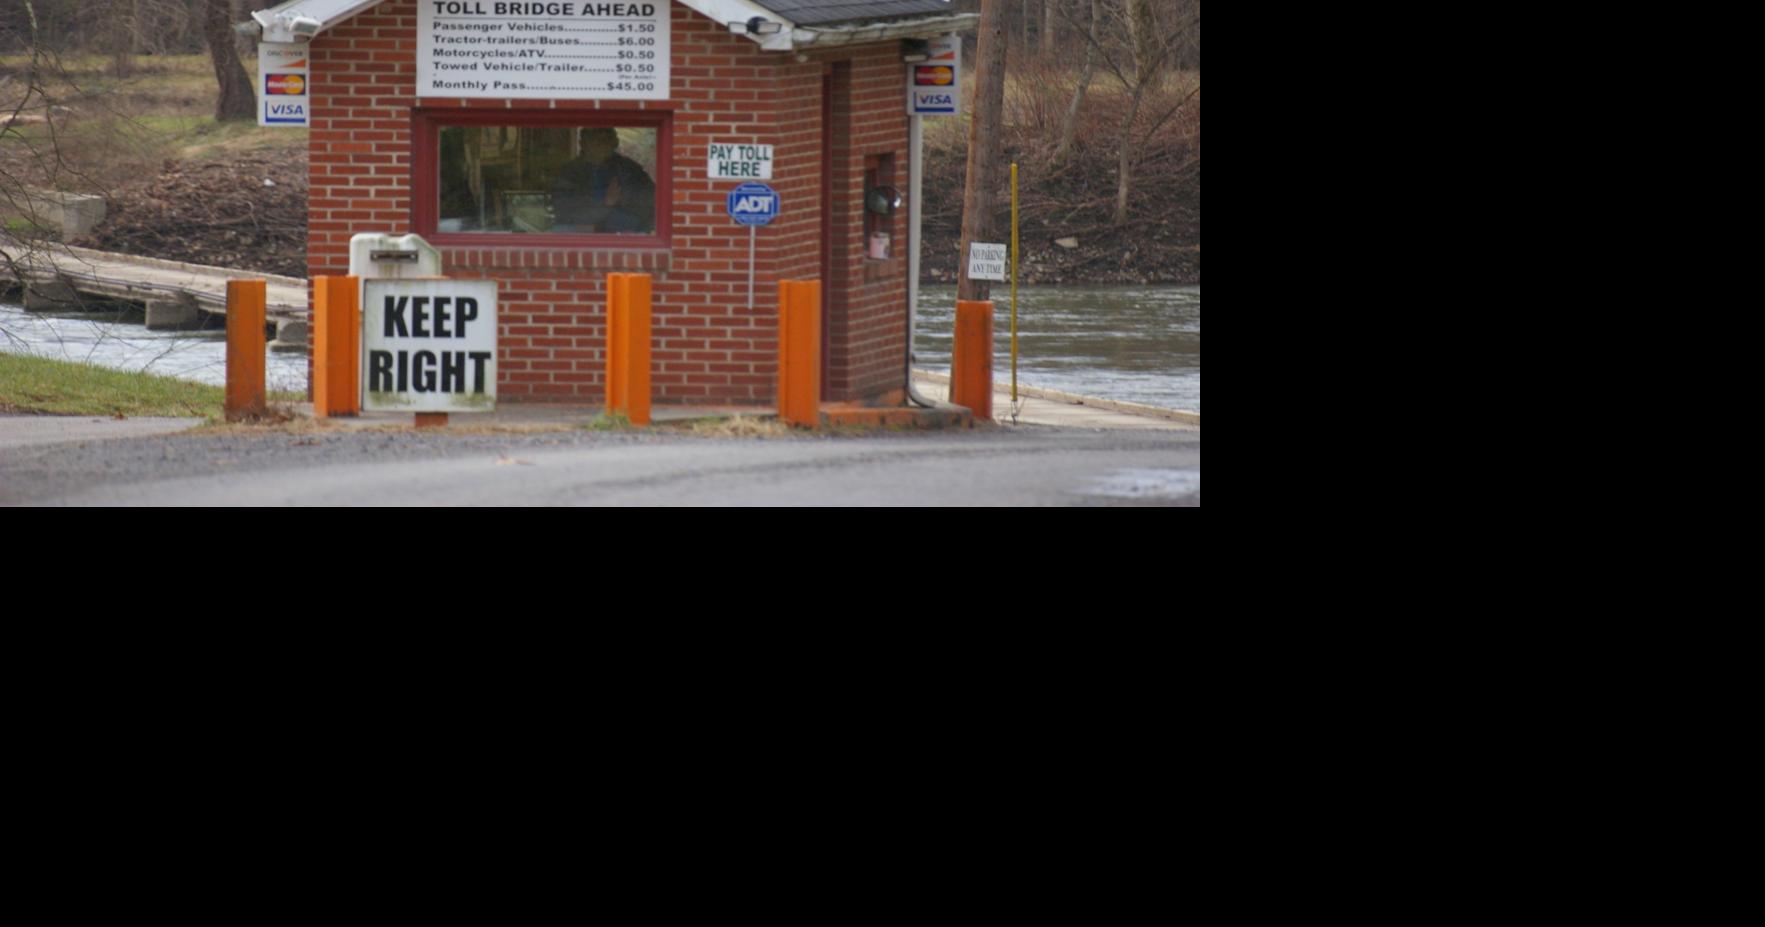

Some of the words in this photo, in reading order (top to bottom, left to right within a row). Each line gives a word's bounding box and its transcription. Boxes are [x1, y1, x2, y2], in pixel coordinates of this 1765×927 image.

[433, 1, 487, 15] TOLL
[494, 2, 574, 16] BRIDGE
[582, 3, 655, 17] AHEAD
[433, 21, 503, 32] Passenger
[507, 22, 564, 32] Vehicles
[618, 23, 655, 33] $1.50
[618, 36, 655, 46] $6.00
[433, 48, 545, 59] Motorcycles/ATV
[618, 50, 655, 60] $0.50
[433, 61, 478, 71] Towed
[616, 63, 655, 73] $0.50
[432, 79, 488, 91] Monthly
[493, 80, 526, 90] Pass
[606, 81, 655, 92] $45.00
[920, 94, 952, 105] VISA
[271, 104, 304, 115] VISA
[710, 145, 734, 160] PAY
[738, 146, 771, 161] TOLL
[718, 161, 761, 177] HERE
[735, 196, 772, 213] ADT
[383, 295, 479, 339] KEEP
[369, 349, 492, 394] RIGHT
